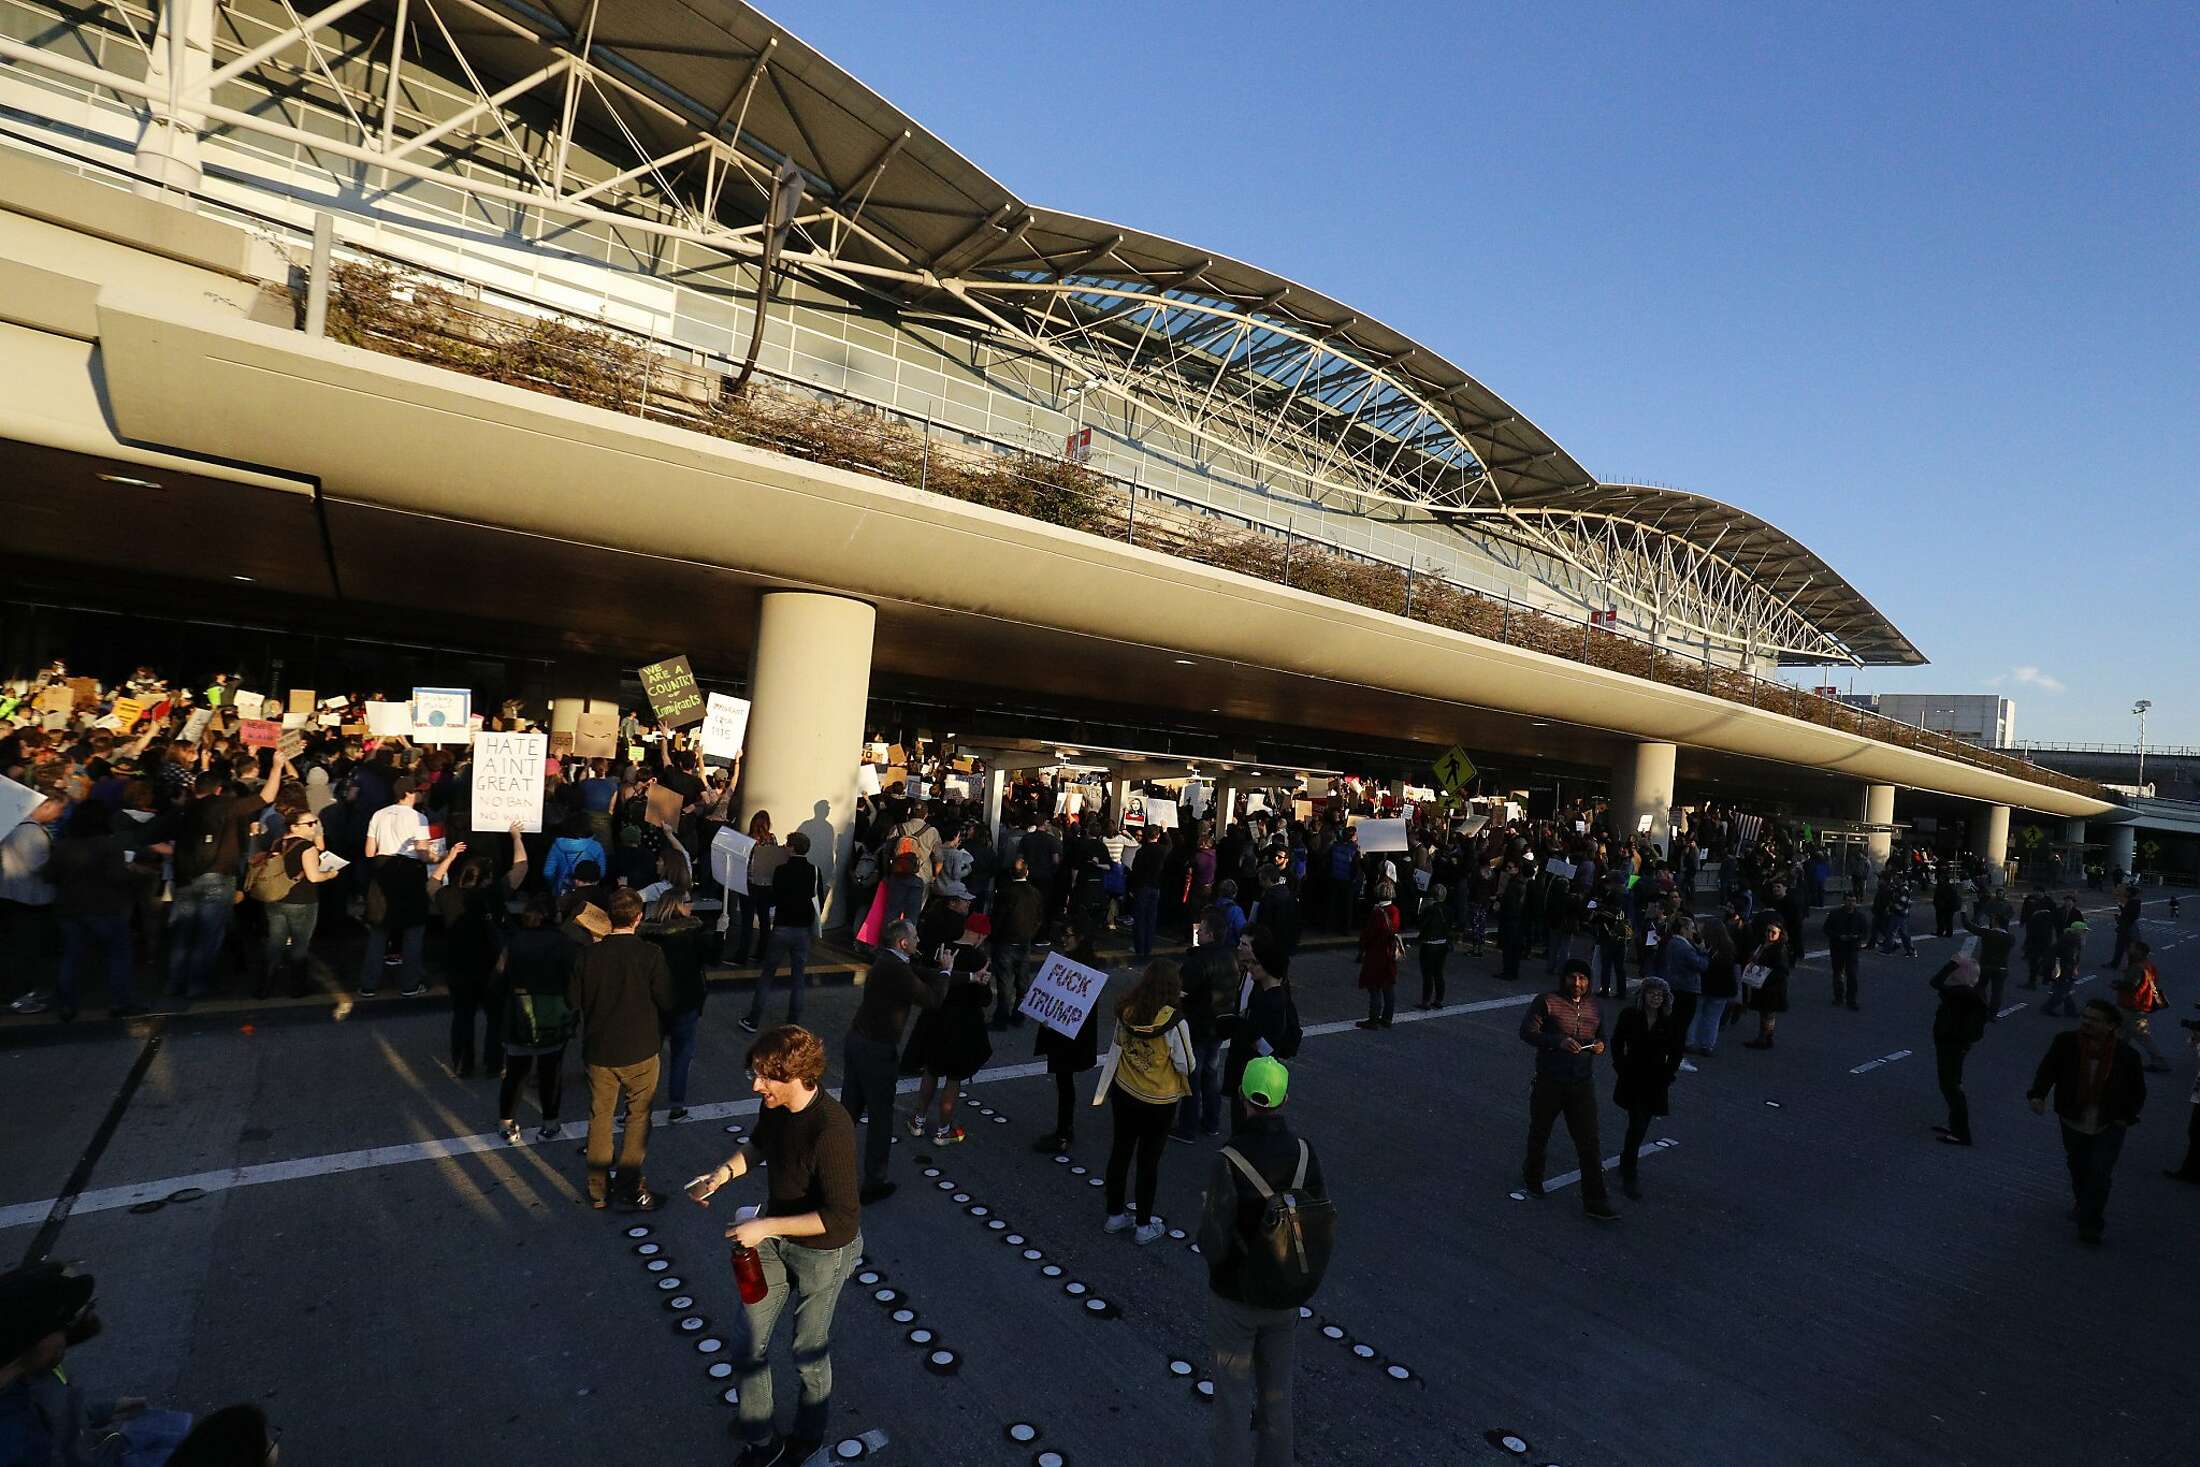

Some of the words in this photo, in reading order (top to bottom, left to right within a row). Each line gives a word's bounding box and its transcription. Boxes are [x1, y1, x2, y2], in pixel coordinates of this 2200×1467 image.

[642, 664, 663, 675] WE
[648, 670, 671, 684] ARE
[675, 664, 684, 674] A
[647, 672, 695, 697] COUNTRY
[486, 738, 540, 756] HATE
[483, 757, 538, 776] AINT
[476, 775, 534, 792] GREAT
[479, 796, 502, 808] NO
[507, 796, 533, 808] BAN
[479, 812, 498, 821] NO
[1047, 963, 1092, 997] FUCK
[1028, 987, 1083, 1026] TRUMP
